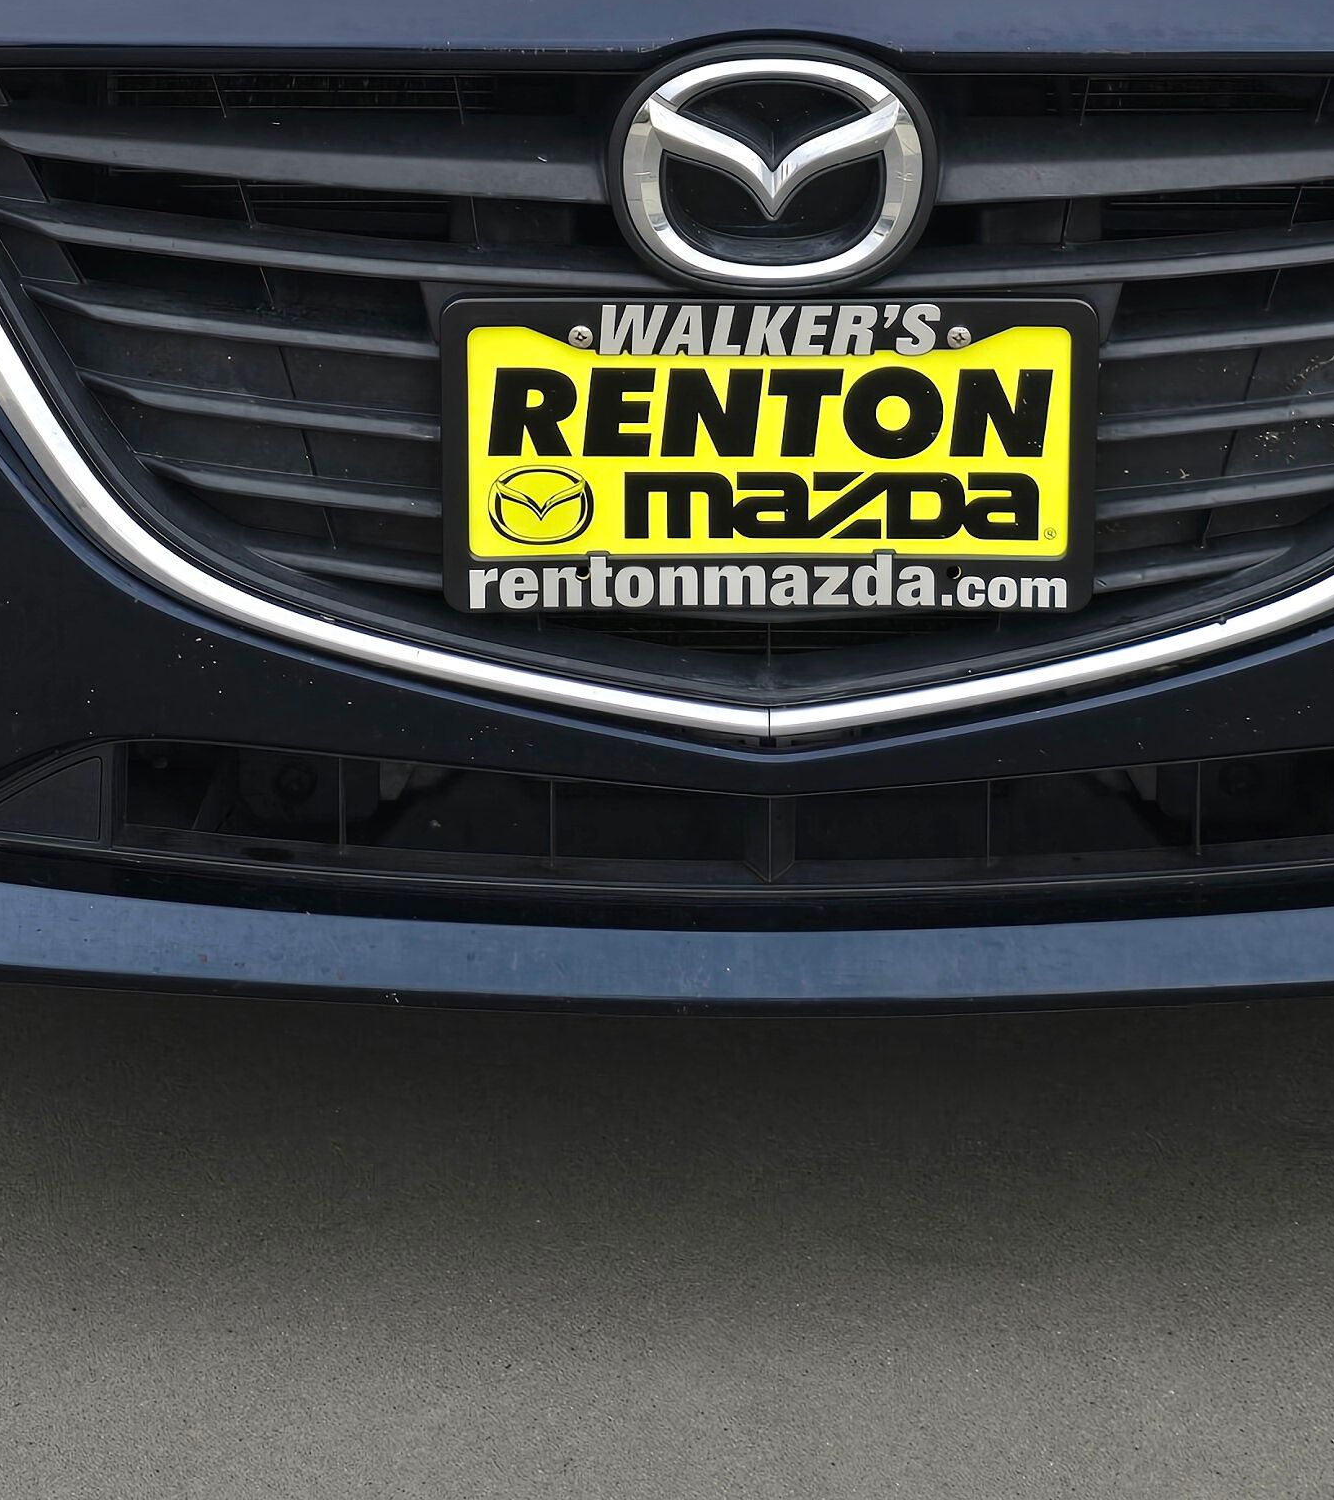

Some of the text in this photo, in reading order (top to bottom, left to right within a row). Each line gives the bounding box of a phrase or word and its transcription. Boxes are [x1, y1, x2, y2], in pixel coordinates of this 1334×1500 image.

[599, 303, 941, 355] WALKER'S
[487, 366, 1054, 460] RENTON
[468, 553, 1067, 609] rentonmazda.com
